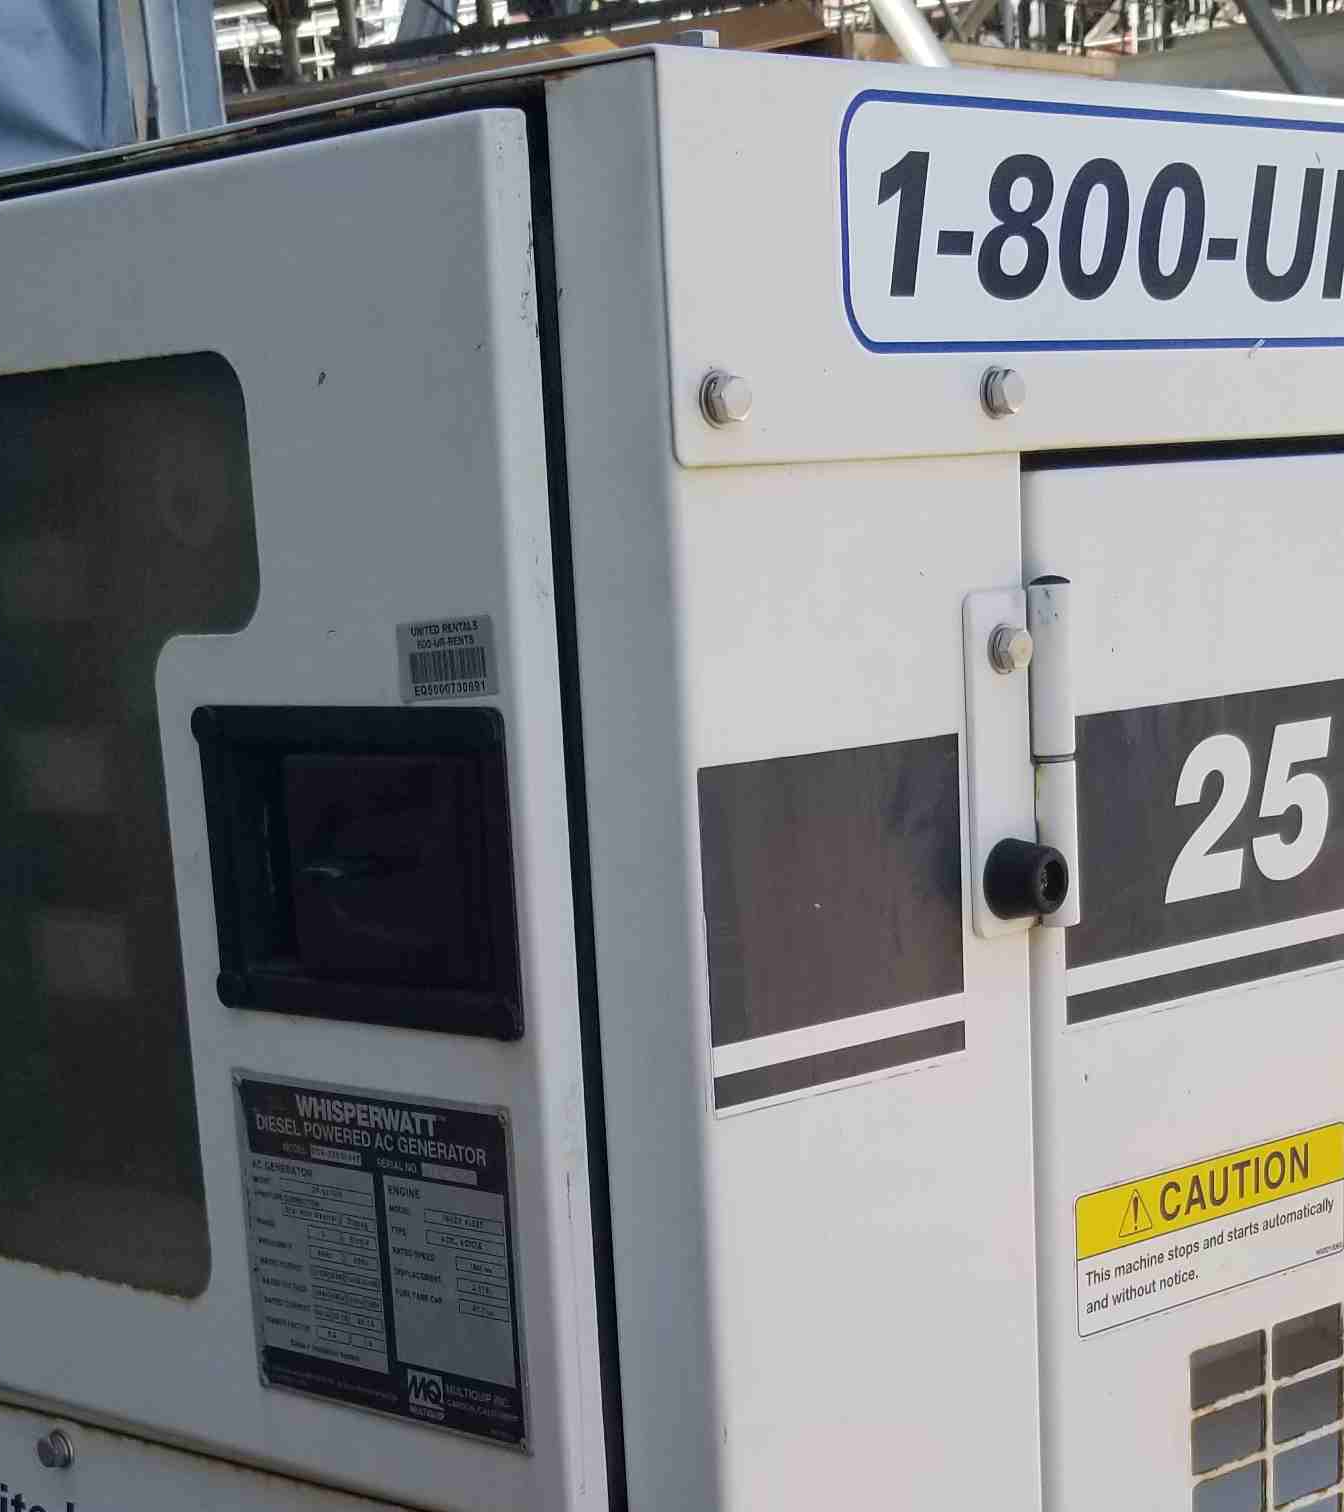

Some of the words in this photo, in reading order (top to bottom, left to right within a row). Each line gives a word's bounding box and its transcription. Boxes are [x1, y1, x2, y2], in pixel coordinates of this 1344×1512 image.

[410, 624, 440, 637] UNITED
[441, 619, 479, 633] RENTALS
[1164, 715, 1333, 905] 25
[256, 1112, 301, 1137] DIESEL
[304, 1120, 371, 1148] POWERED
[374, 1134, 395, 1152] AC
[397, 1137, 487, 1168] GENERATOR
[387, 1184, 421, 1200] ENGINE
[1158, 1142, 1310, 1222] CAUTION
[1085, 1267, 1111, 1287] This
[1114, 1252, 1165, 1278] machine
[1167, 1241, 1200, 1261] stops
[1202, 1228, 1224, 1250] and
[1227, 1221, 1259, 1242] starts
[1262, 1197, 1335, 1232] automatically
[1086, 1293, 1109, 1314] and
[1112, 1279, 1157, 1306] without
[1159, 1269, 1199, 1290] notice.
